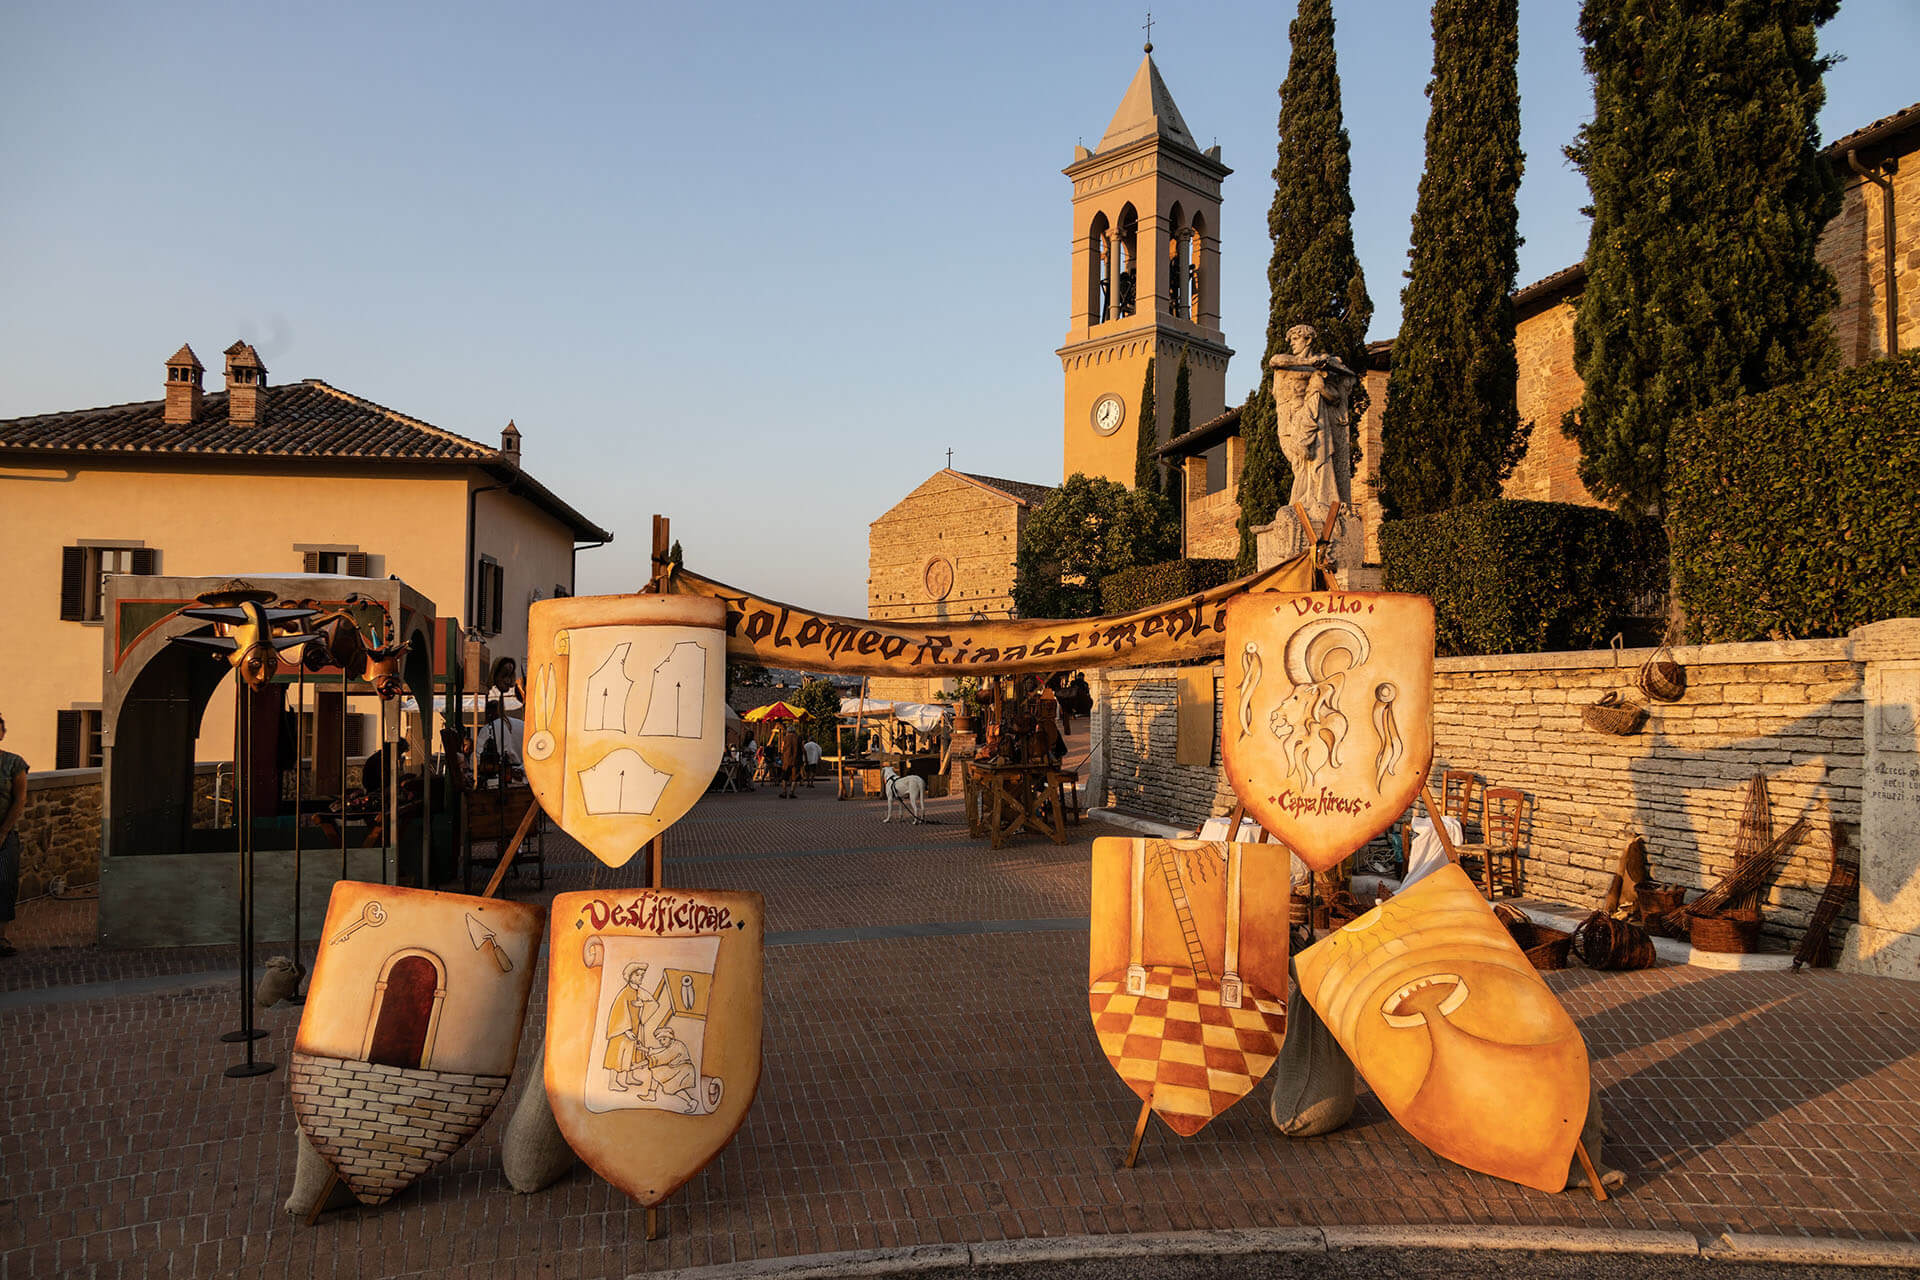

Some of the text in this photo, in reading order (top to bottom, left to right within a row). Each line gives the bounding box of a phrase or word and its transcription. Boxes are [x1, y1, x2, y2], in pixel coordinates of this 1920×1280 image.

[1288, 594, 1363, 617] Vello
[1277, 788, 1317, 820] Capra
[580, 891, 733, 936] Vestificinae
